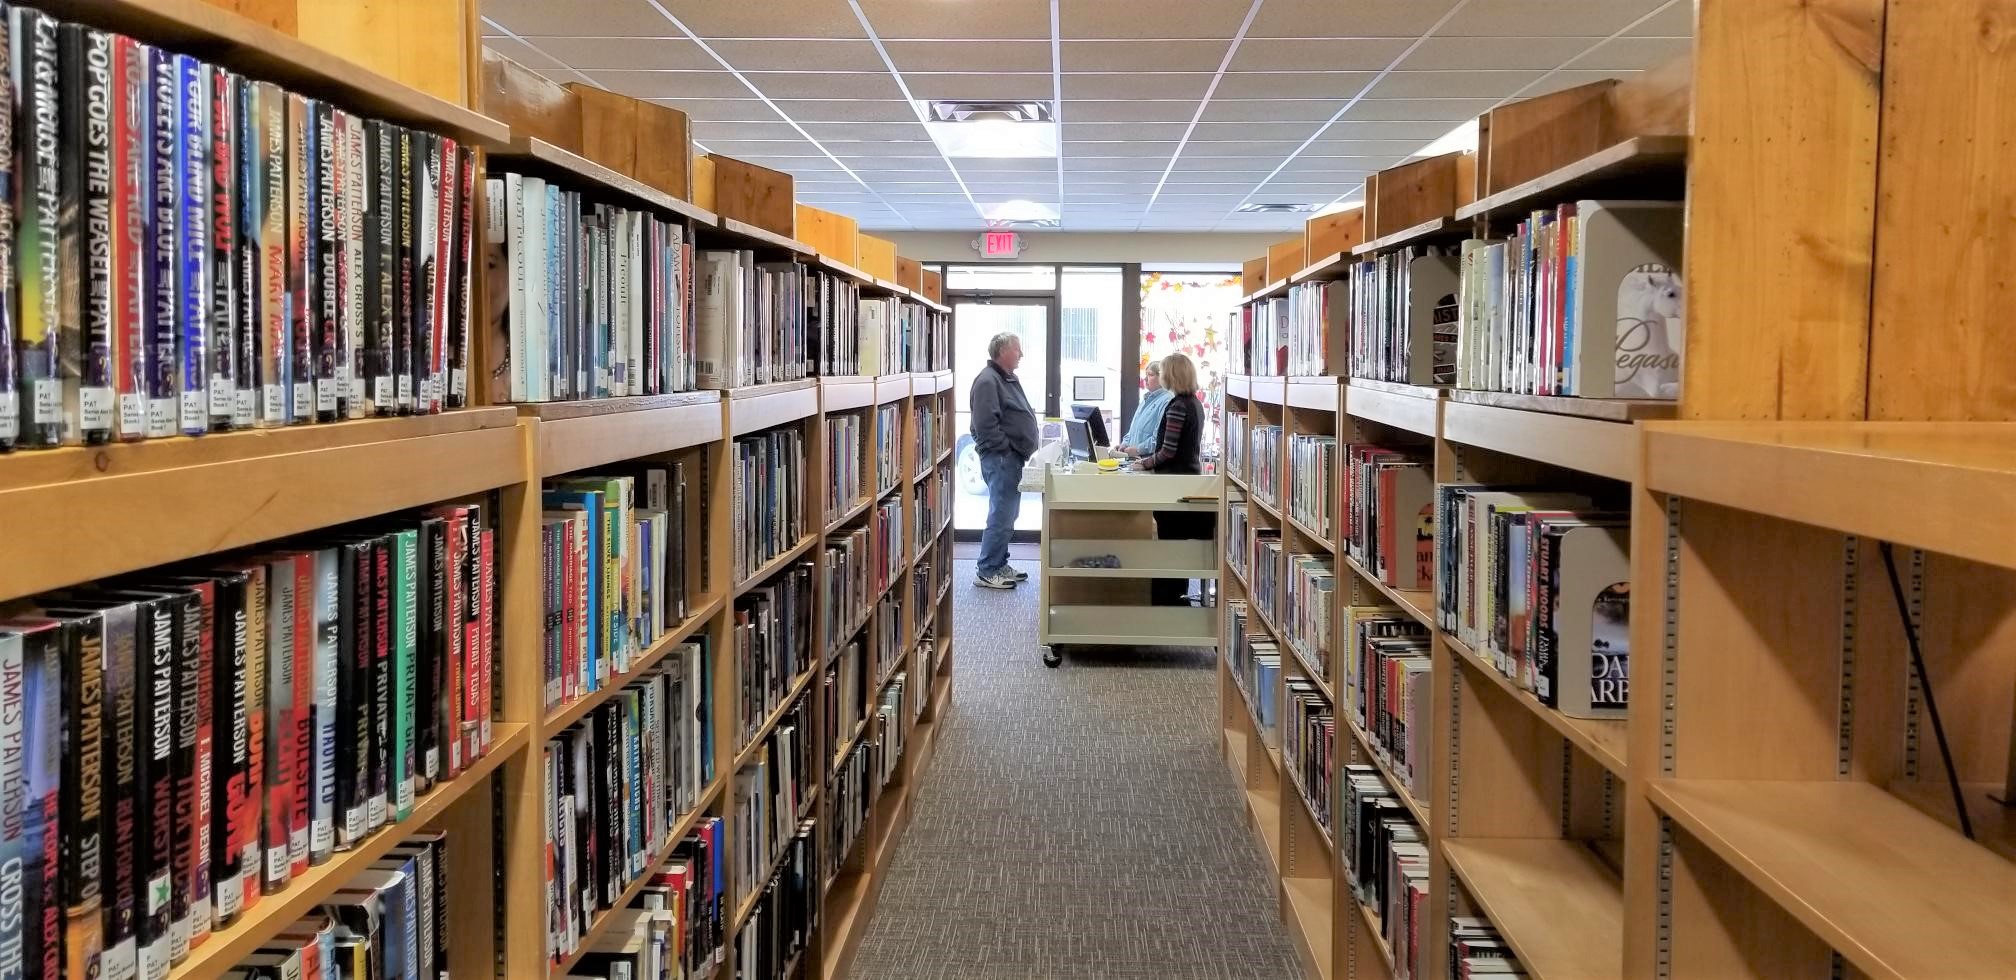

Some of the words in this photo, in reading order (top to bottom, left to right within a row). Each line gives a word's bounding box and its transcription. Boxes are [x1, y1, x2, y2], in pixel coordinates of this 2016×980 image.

[88, 32, 108, 85] POP
[36, 83, 58, 168] MOUSE
[89, 85, 109, 146] GOES
[157, 63, 173, 154] VIOLETS
[269, 106, 283, 152] JAMES
[127, 133, 142, 189] ARE
[319, 114, 334, 163] JAMES
[350, 124, 363, 167] JAMES
[380, 130, 393, 173] JAMES
[401, 134, 411, 176] JAMES
[430, 148, 439, 185] JAMES
[445, 147, 454, 183] JAMES
[89, 149, 108, 193] THE
[158, 157, 173, 203] ARE
[187, 134, 204, 202] BLIND
[269, 154, 283, 233] PATTERSON
[463, 159, 471, 199] JAMES
[127, 193, 143, 245] RED
[214, 192, 232, 252] WOLF
[321, 163, 335, 240] PATTERSON
[335, 170, 347, 240] PATTERSON
[351, 171, 363, 241] PATTERSON
[380, 175, 393, 245] PATTERSON
[401, 179, 411, 248] PATTERSON
[442, 186, 453, 242] PATTERSON
[515, 181, 524, 219] JODI
[89, 198, 109, 279] WEASEL
[158, 207, 173, 262] BLUE
[188, 206, 204, 263] MICE
[461, 201, 471, 263] PATTERSON
[515, 227, 524, 293] PICOULT
[672, 233, 681, 272] ADAM
[988, 235, 1013, 253] EXIT
[269, 245, 284, 305] MARY
[323, 252, 335, 319] DOUBLE
[354, 248, 363, 279] ALEX
[427, 261, 436, 288] KILL
[619, 253, 628, 304] Picoult
[354, 284, 363, 338] CROSS'S
[380, 271, 393, 316] ALEX
[426, 293, 435, 325] ALEX
[461, 275, 469, 310] CROSS
[405, 540, 417, 581] JAMES
[433, 534, 444, 571] JAMES
[471, 518, 481, 555] JAMES
[1539, 537, 1550, 582] STUART
[358, 552, 370, 596] JAMES
[376, 547, 388, 588] JAMES
[452, 552, 462, 591] JAMES
[471, 556, 481, 616] PATTERSON
[485, 560, 494, 603] JAMES
[581, 530, 589, 639] REVENANT
[254, 578, 265, 625] JAMES
[282, 587, 294, 624] JAMES
[326, 572, 339, 621] JAMES
[376, 589, 388, 657] PATTERSON
[405, 582, 417, 649] PATTERSON
[433, 572, 444, 632] PATTERSON
[452, 591, 462, 655] PATTERSON
[1539, 584, 1549, 629] WOODS
[154, 610, 171, 666] JAMES
[182, 603, 200, 657] JAMES
[234, 609, 247, 666] JAMES
[281, 625, 294, 686] PATTERSON
[358, 597, 370, 669] PATTERSON
[471, 626, 480, 669] PRIVATE
[3, 658, 22, 726] JAMES
[81, 635, 102, 704] JAMES
[254, 629, 265, 708] PATTERSON
[326, 625, 339, 709] PATTERSON
[405, 652, 415, 723] PRIVATE
[471, 671, 480, 706] VEGAS
[154, 667, 171, 760] PATTERSON
[179, 658, 199, 749] PATTERSON
[233, 669, 246, 765] PATTERSON
[81, 704, 102, 821] PATTERSON
[116, 688, 133, 785] PATTERSON
[321, 722, 336, 805] HAUNTED
[3, 730, 22, 843] PATTERSON
[199, 752, 211, 821] MICHAEL
[296, 719, 309, 821] BULLSEYE
[153, 775, 171, 864] WORST
[176, 774, 195, 834] TICK
[226, 771, 246, 865] GONE
[558, 796, 566, 848] REICHS
[43, 819, 58, 881] PEOPLE
[80, 833, 100, 879] STEP
[1, 856, 22, 932] CROSS
[405, 872, 416, 911] JAMES
[422, 860, 433, 900] JAMES
[0, 930, 22, 979] THE
[43, 906, 58, 948] ALEX
[405, 912, 417, 980] PATTERSON
[422, 901, 433, 968] PATTERSON
